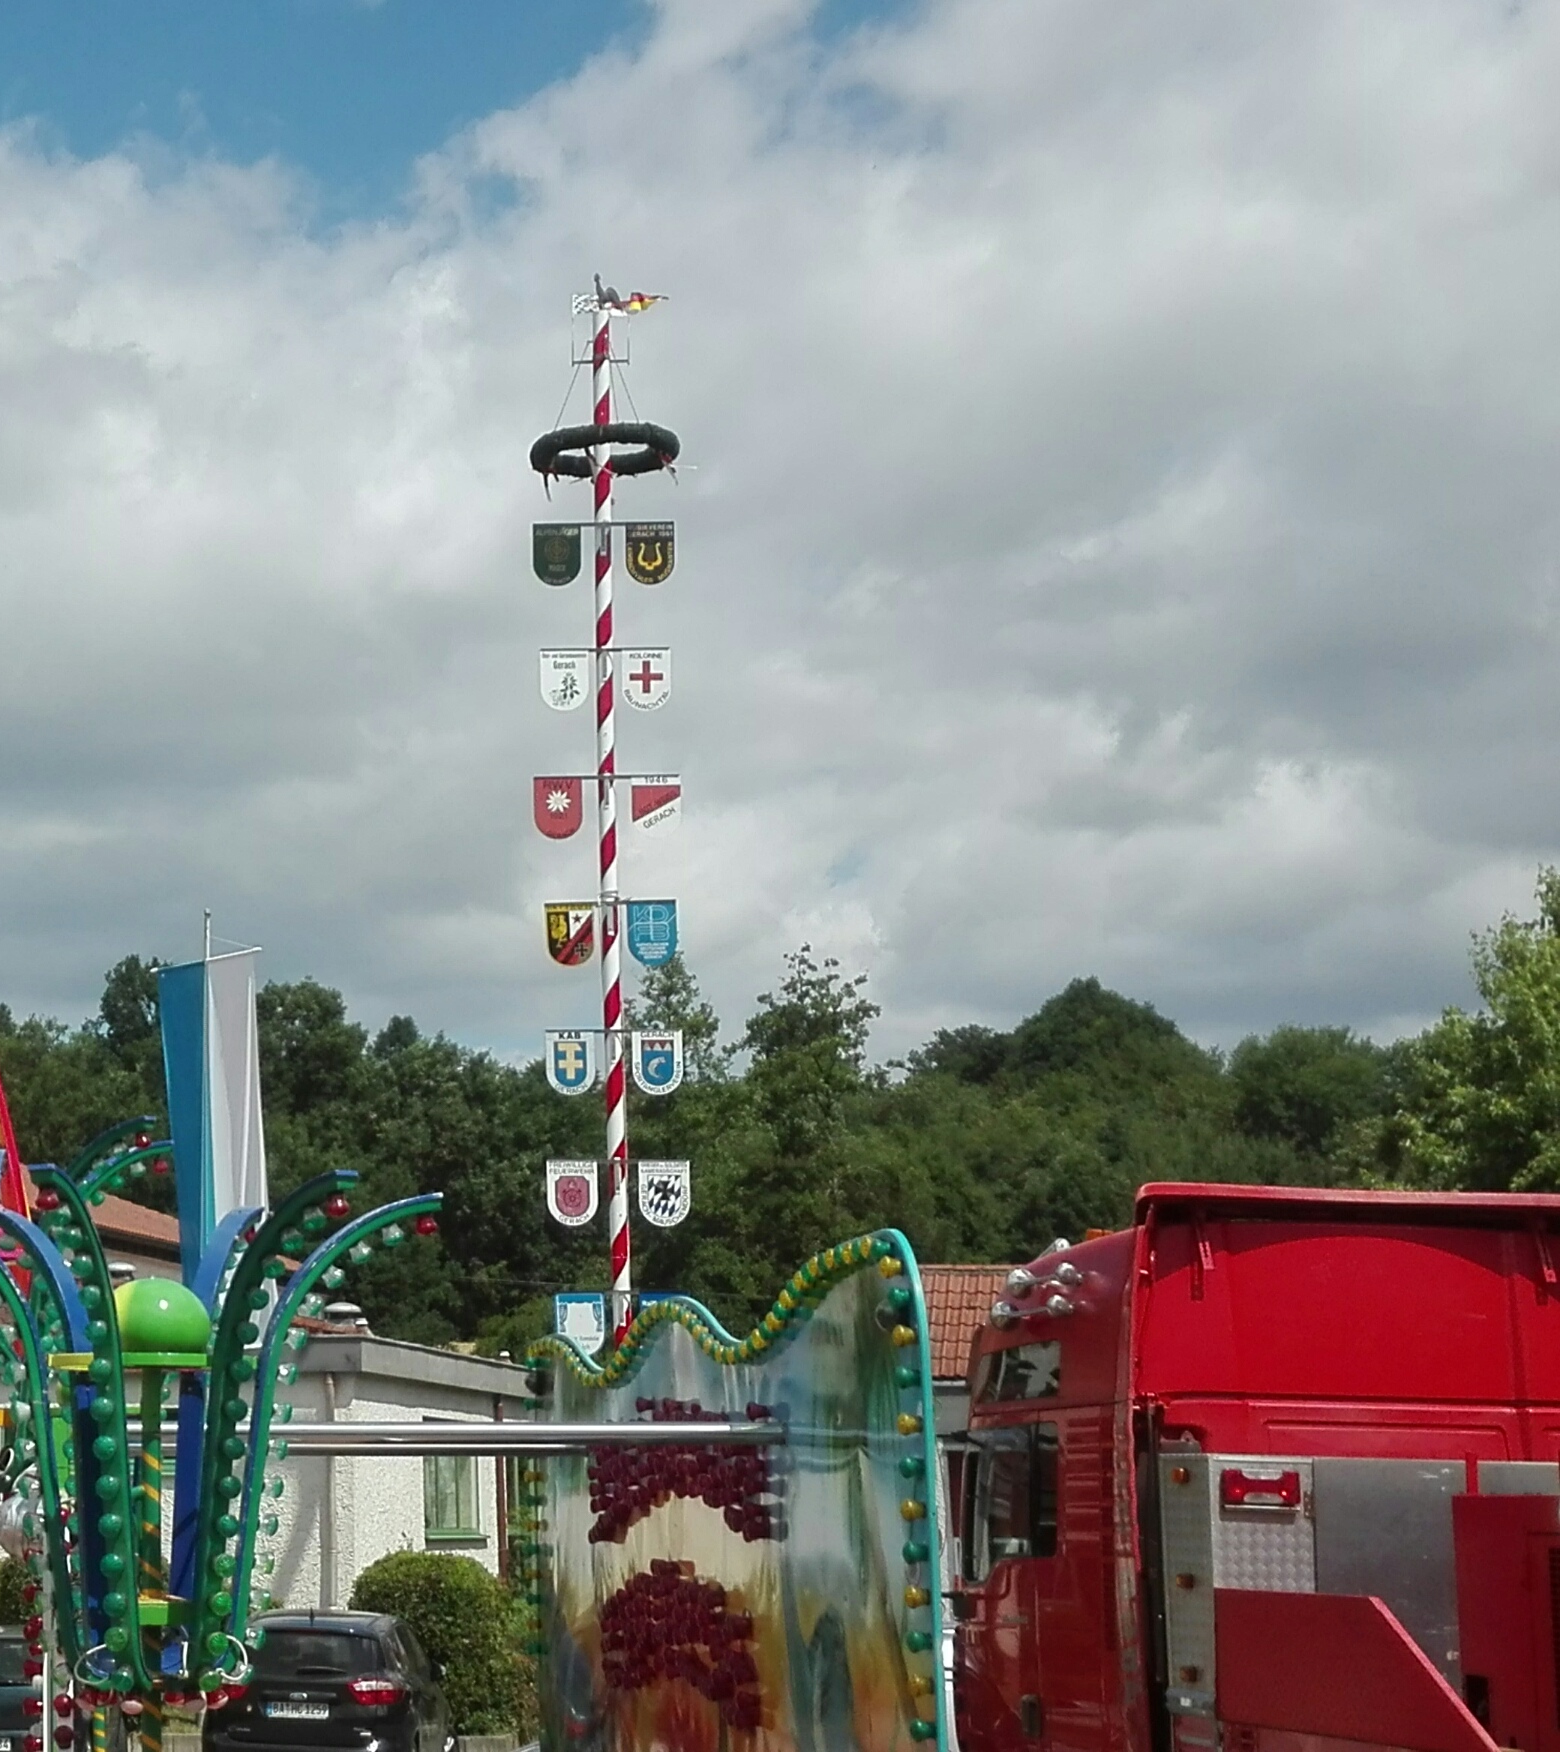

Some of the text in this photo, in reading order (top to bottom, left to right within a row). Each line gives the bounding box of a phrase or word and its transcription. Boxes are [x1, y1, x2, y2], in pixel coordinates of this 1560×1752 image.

[553, 660, 576, 670] Gerach
[643, 806, 677, 829] GERACH
[558, 1031, 581, 1039] KAB
[640, 1030, 674, 1038] GERACH
[554, 1082, 588, 1093] GERACH
[558, 1214, 590, 1225] GERACH
